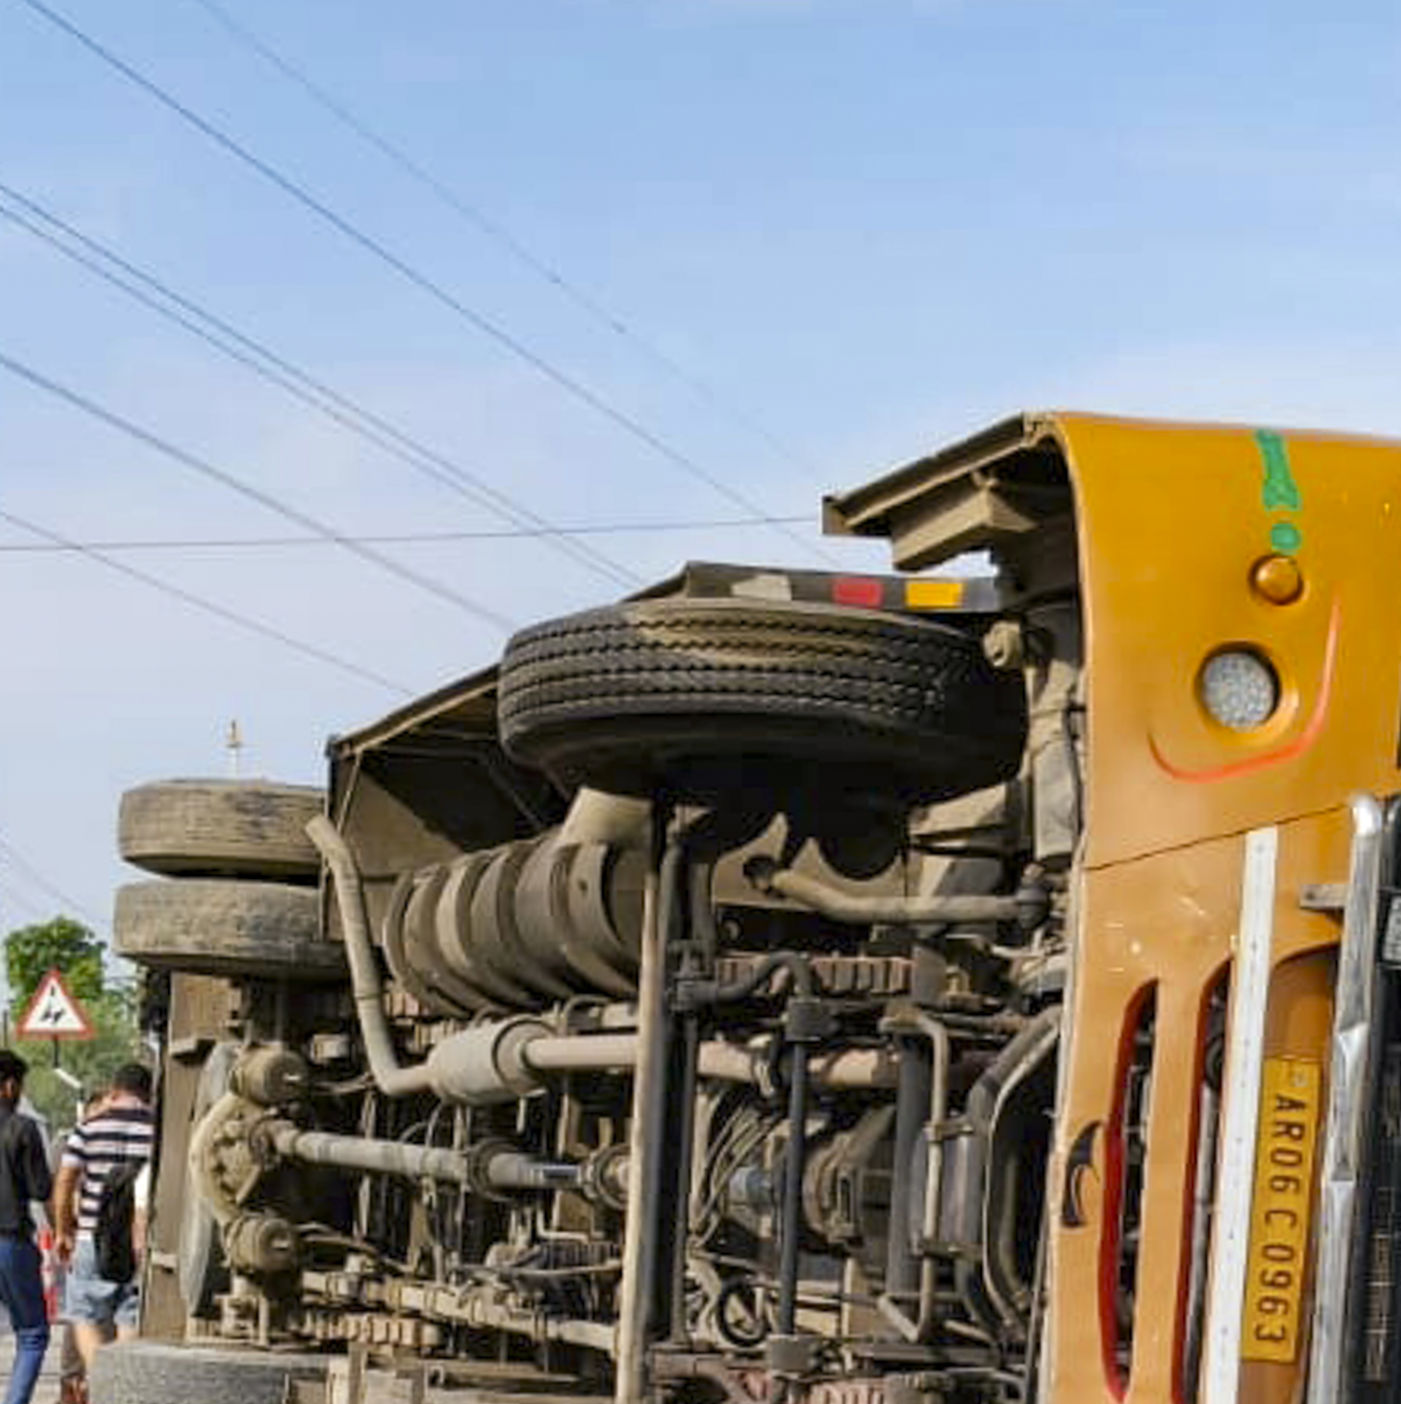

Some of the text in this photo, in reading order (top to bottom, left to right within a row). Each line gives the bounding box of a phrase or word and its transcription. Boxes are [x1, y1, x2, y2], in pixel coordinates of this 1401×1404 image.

[1255, 1093, 1307, 1341] AR06 C 0963
